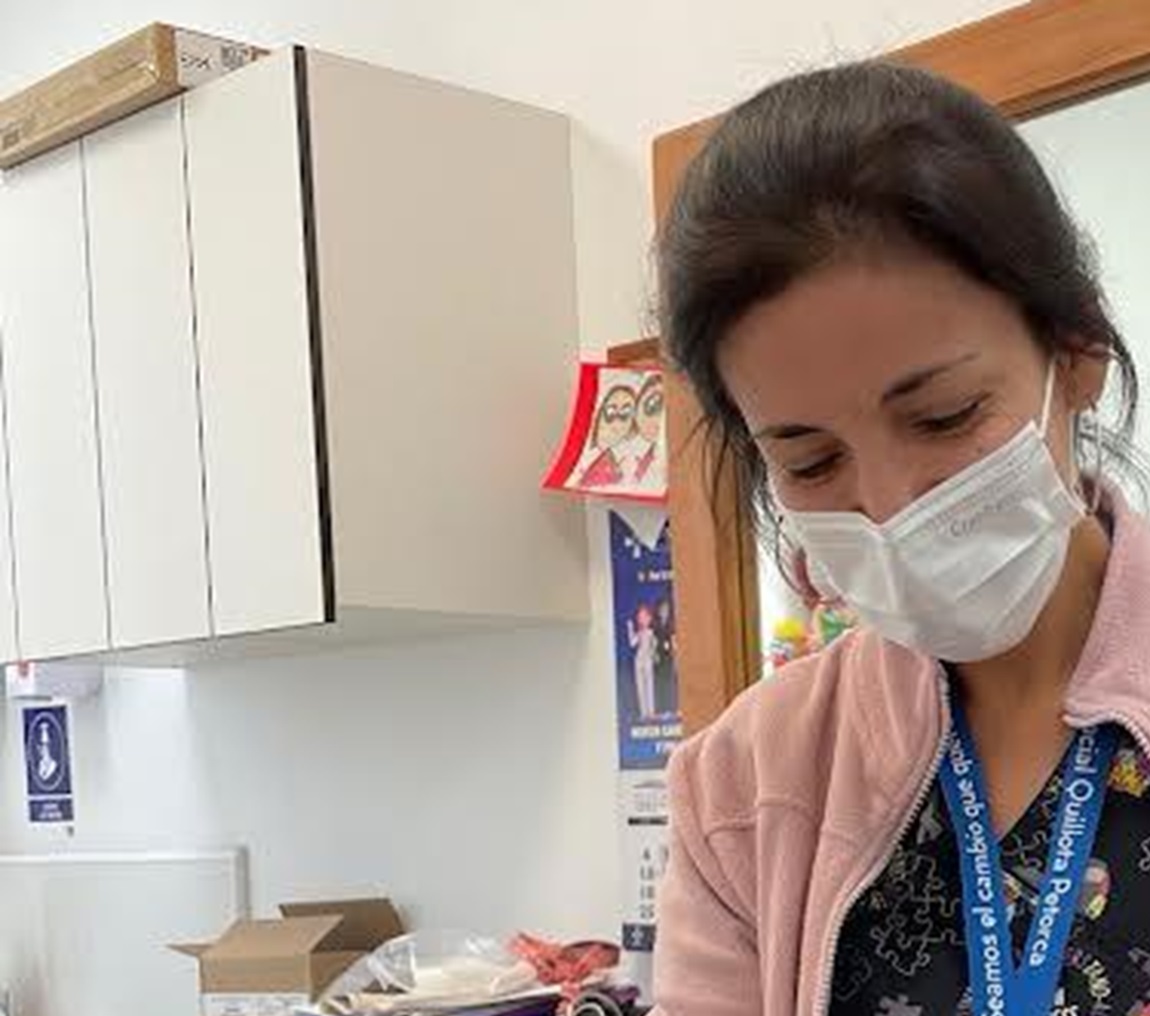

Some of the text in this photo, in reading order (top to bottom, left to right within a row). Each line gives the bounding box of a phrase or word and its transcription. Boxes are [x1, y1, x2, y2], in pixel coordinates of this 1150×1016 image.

[959, 779, 985, 818] que
[1052, 779, 1095, 873] Quillota
[965, 821, 993, 901] cambio
[971, 904, 996, 927] el
[1028, 878, 1072, 968] Petorca
